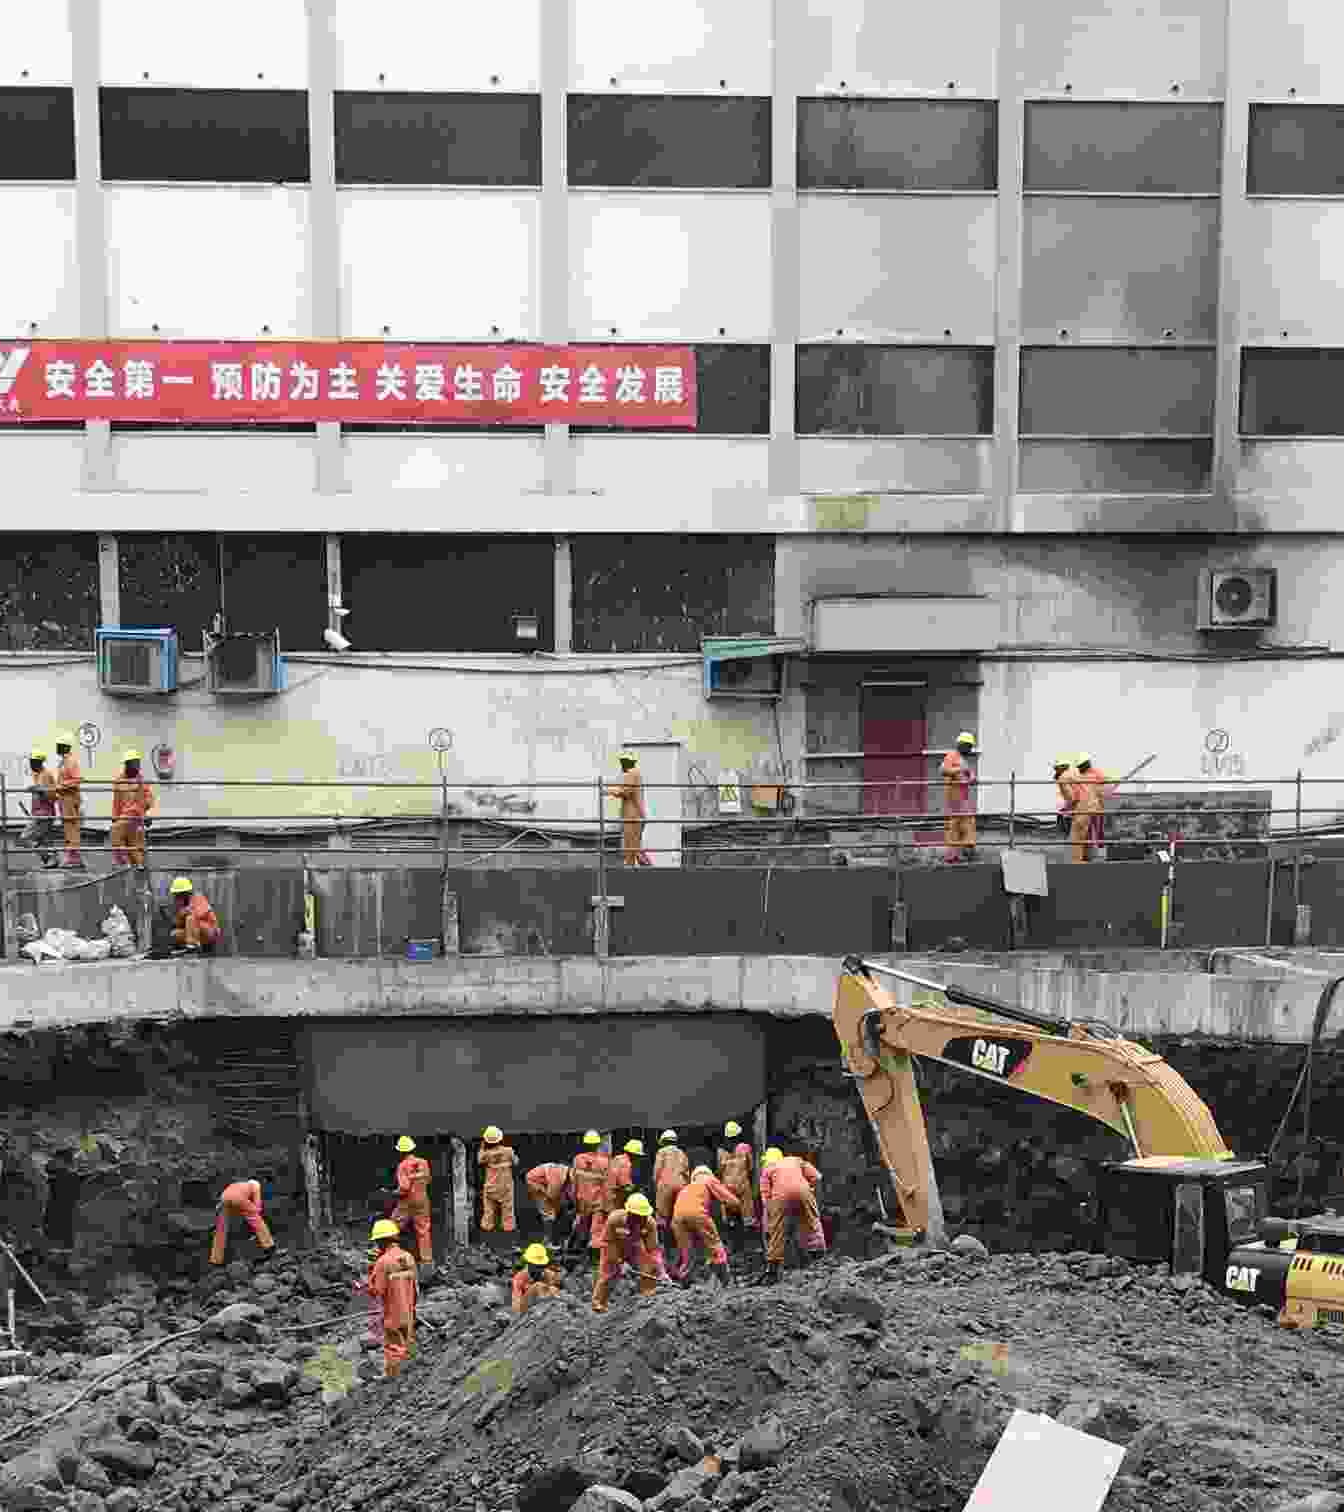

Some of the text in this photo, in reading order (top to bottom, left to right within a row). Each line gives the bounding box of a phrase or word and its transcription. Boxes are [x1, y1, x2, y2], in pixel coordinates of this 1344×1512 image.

[45, 359, 686, 406] 安全第一 预防为主 关爱生命 安全发展
[971, 1038, 1011, 1075] CAT
[1225, 1265, 1261, 1293] CAT
